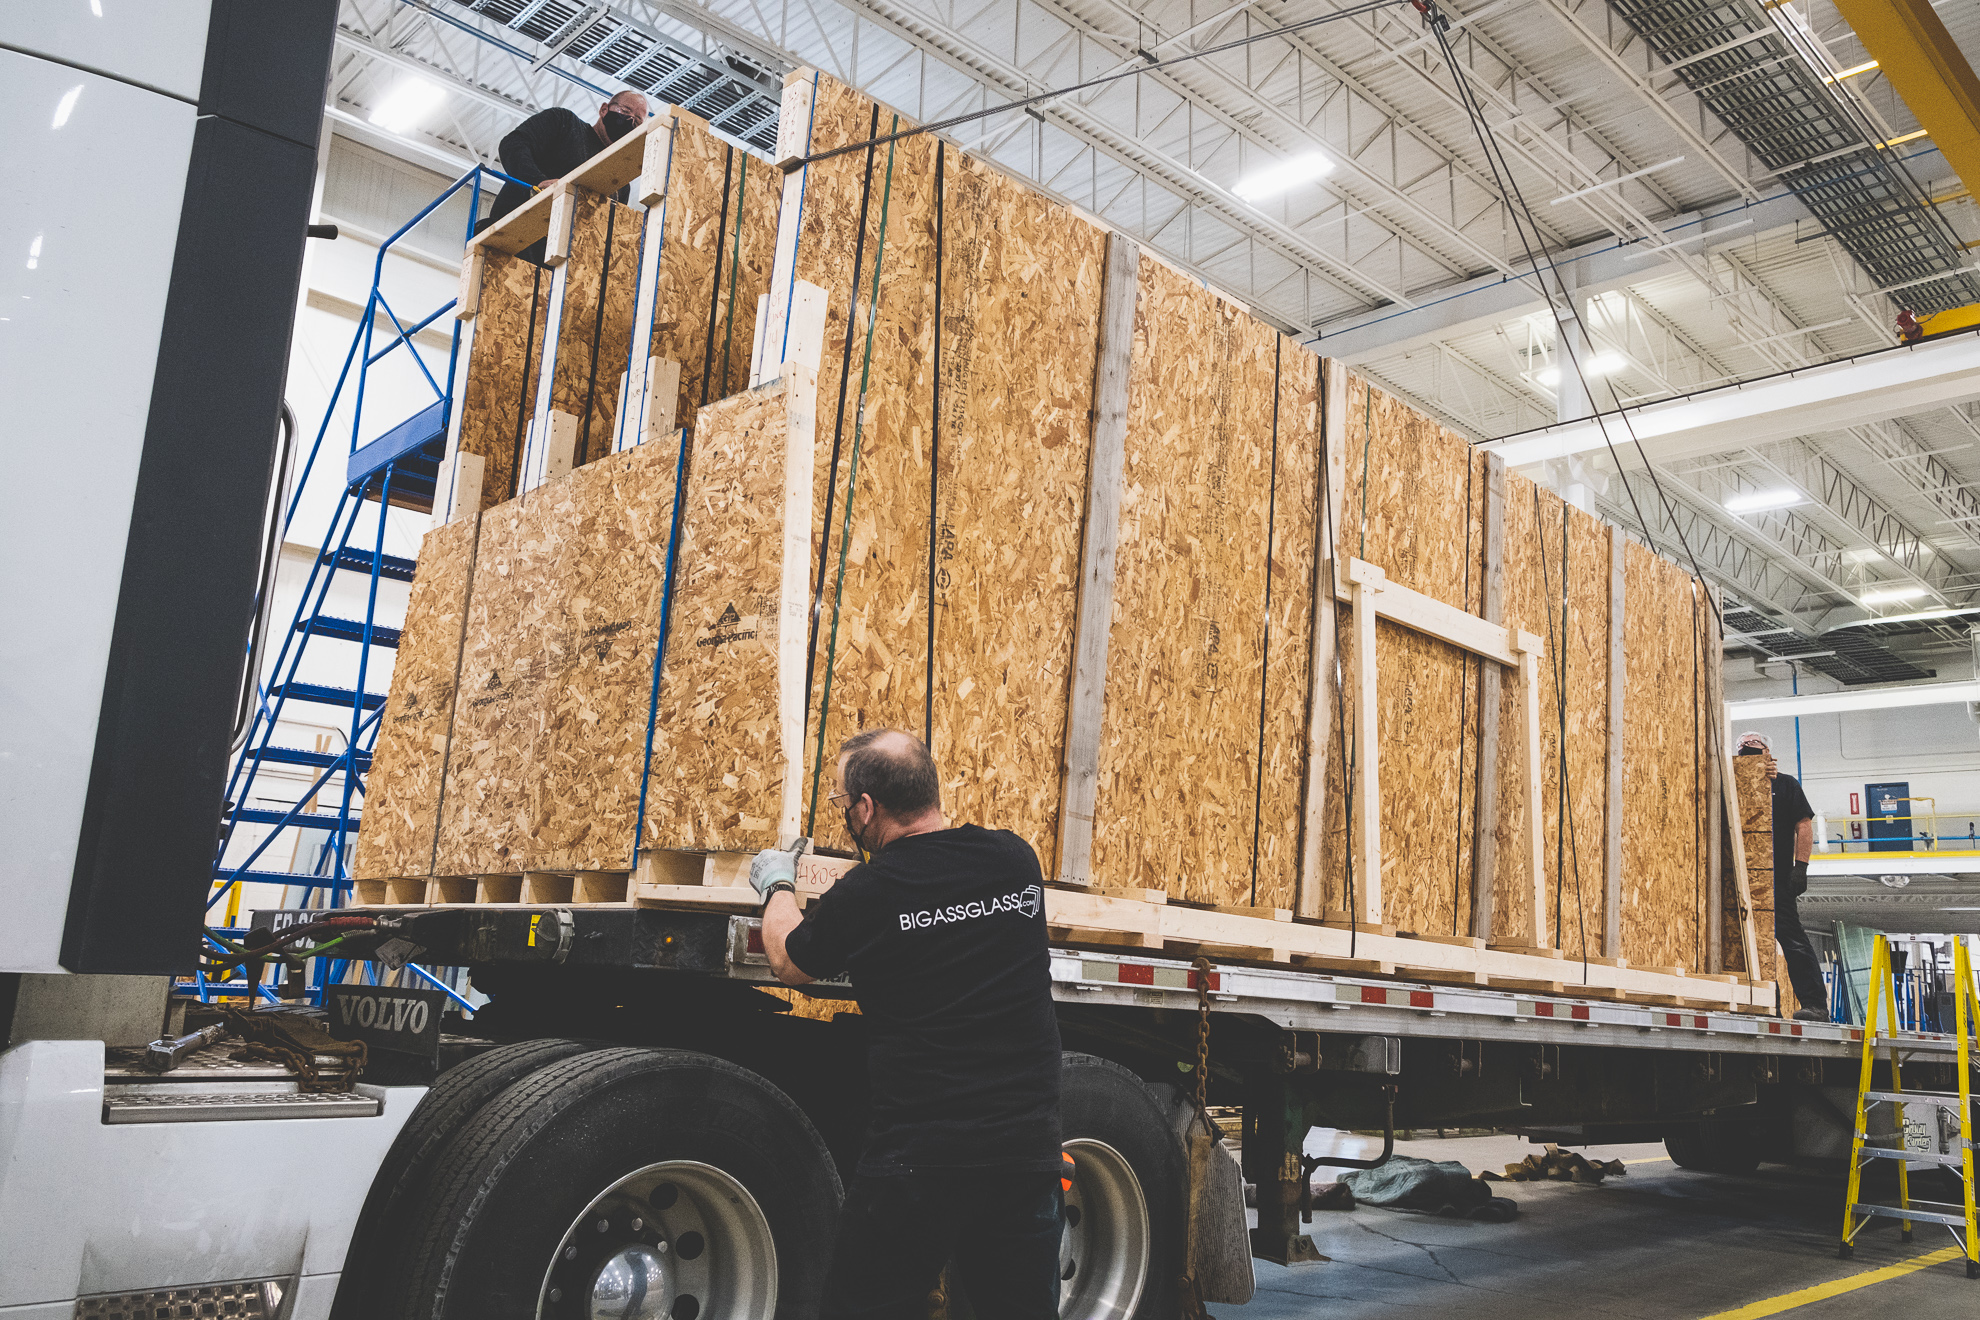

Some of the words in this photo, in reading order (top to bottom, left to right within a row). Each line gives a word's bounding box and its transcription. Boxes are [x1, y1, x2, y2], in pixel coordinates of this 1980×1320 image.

[943, 528, 956, 561] APA
[1404, 687, 1414, 716] APA
[798, 862, 845, 885] 4809
[336, 994, 429, 1034] VOLVO
